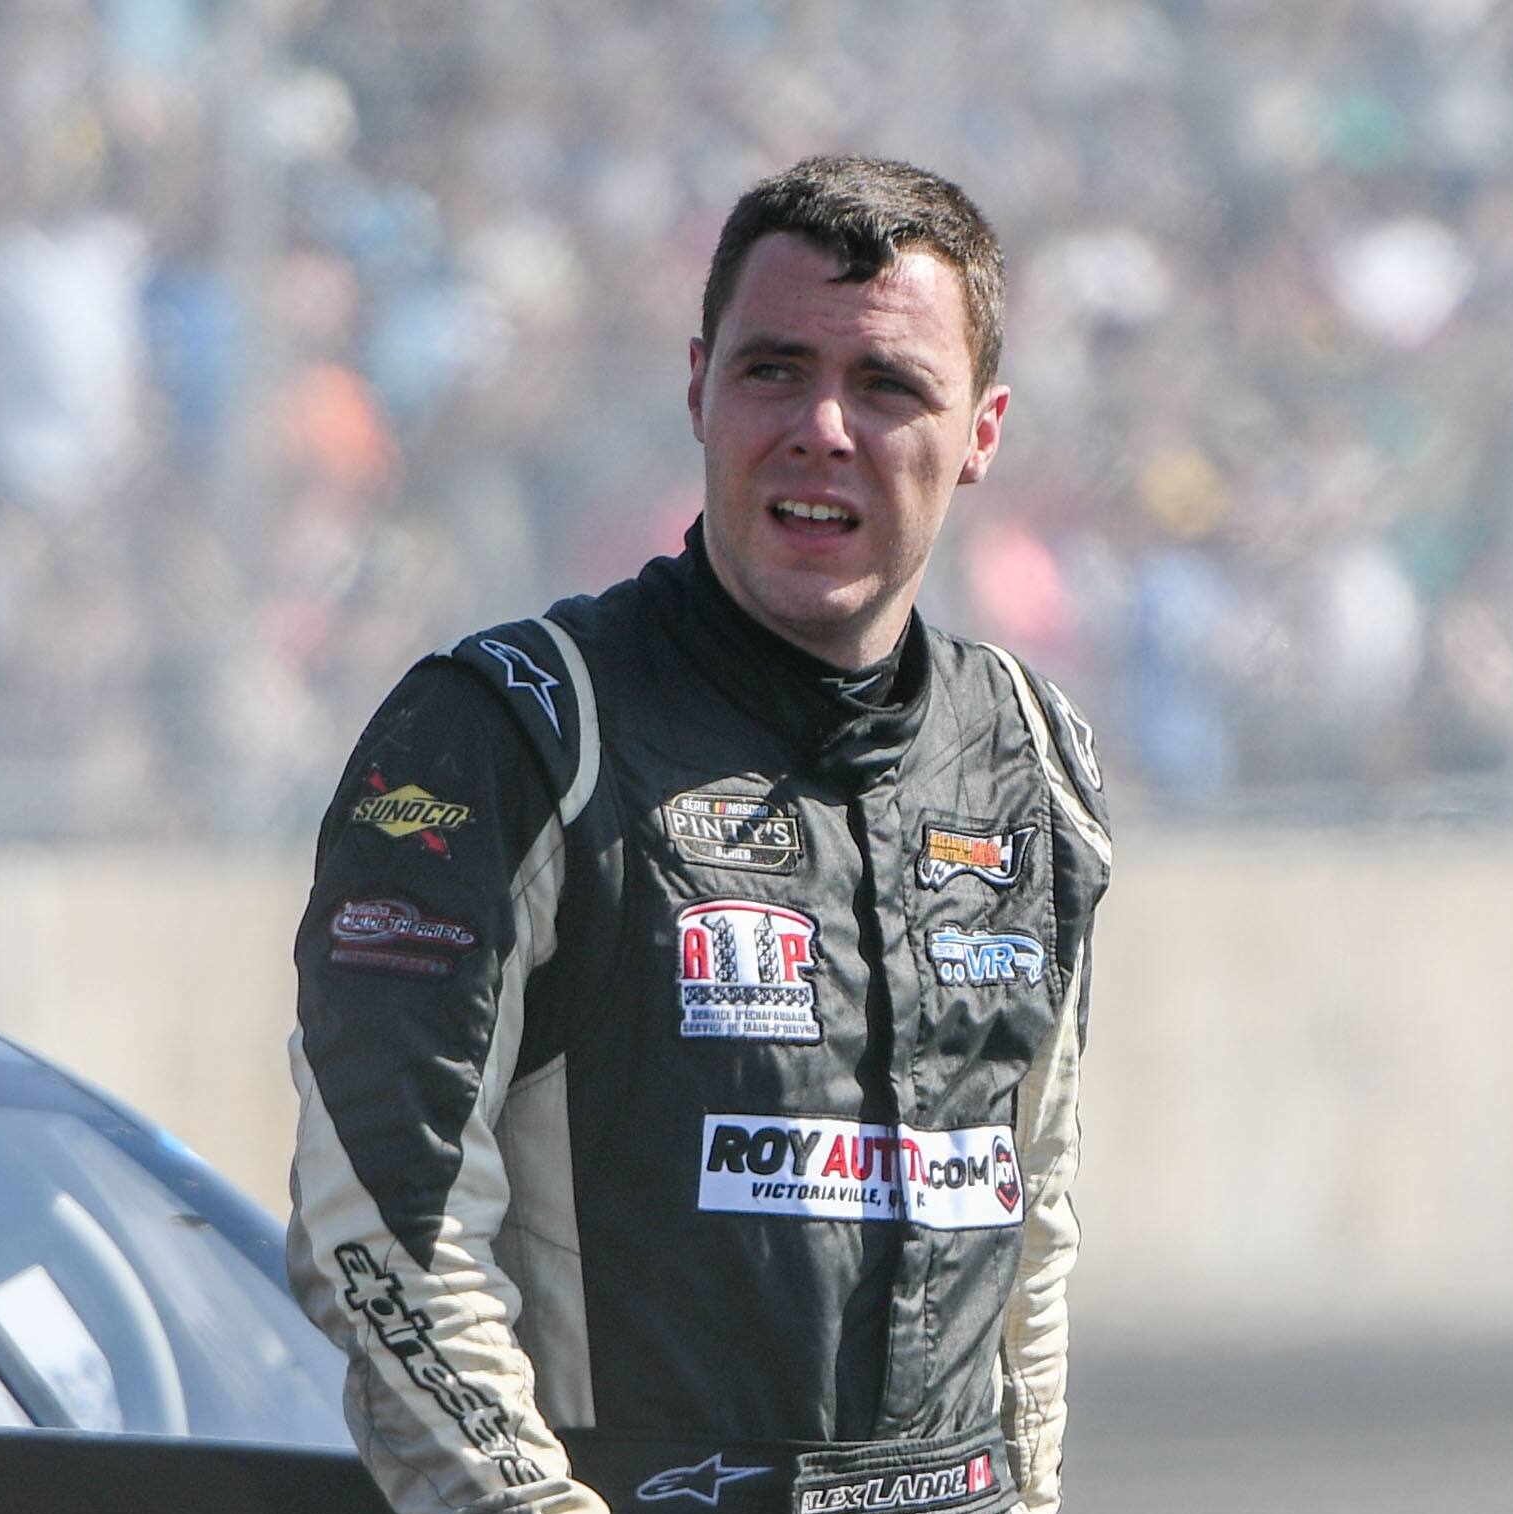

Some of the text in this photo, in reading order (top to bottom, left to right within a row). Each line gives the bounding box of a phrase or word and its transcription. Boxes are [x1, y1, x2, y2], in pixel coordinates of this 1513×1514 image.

[354, 799, 469, 827] SUNOCO
[682, 797, 711, 813] SÉRIE
[673, 812, 791, 846] PINTY'S
[964, 943, 1016, 979] VR
[751, 1182, 881, 1206] VICTORIAVILLE,
[335, 1242, 547, 1487] alpinestas
